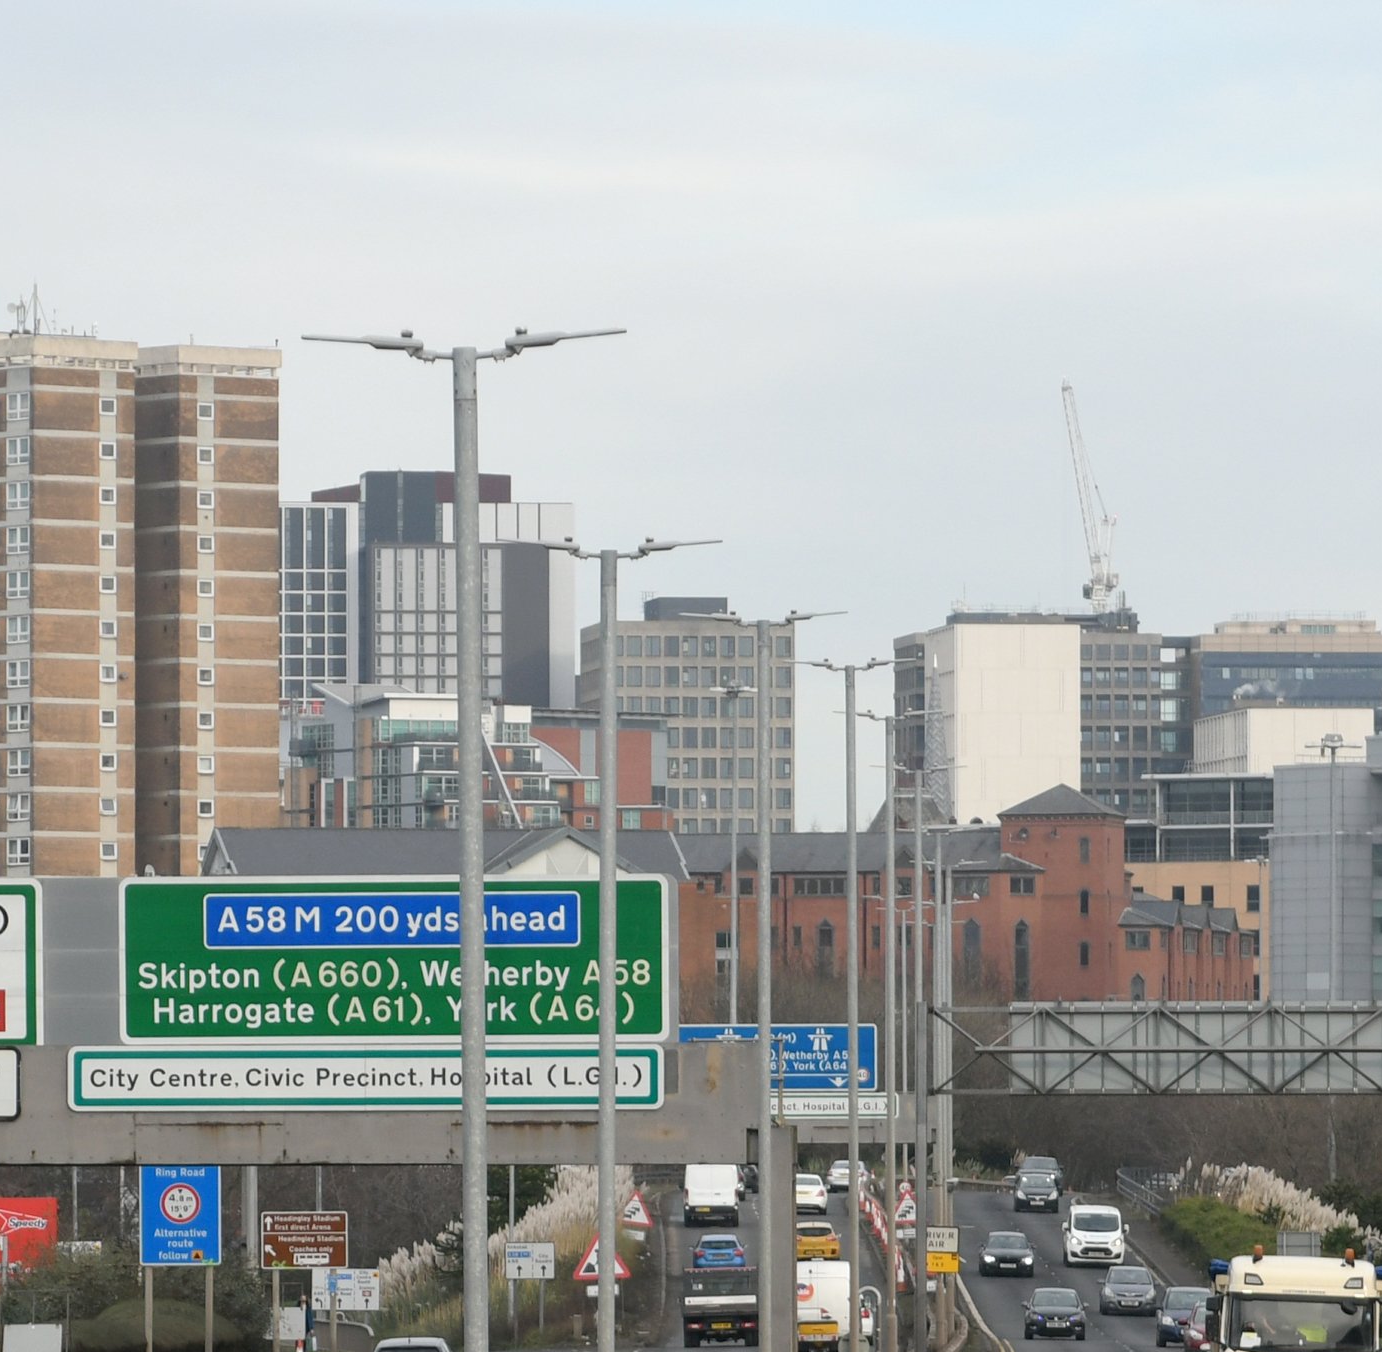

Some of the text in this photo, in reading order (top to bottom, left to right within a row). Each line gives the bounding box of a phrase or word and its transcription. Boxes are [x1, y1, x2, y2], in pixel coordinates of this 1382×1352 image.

[334, 906, 399, 934] 200
[406, 905, 459, 938] yds
[138, 957, 651, 992] Skipton (A660), Weherby A58
[152, 991, 634, 1028] Harrogate (A61), Yrk (A6)
[833, 1050, 848, 1060] A5
[793, 1061, 815, 1070] York
[819, 1061, 847, 1071] (A64
[90, 1067, 138, 1091] City
[245, 1068, 305, 1087] Civic
[430, 1066, 532, 1087] Hopital
[803, 1102, 845, 1112] Hospital
[155, 1167, 205, 1178] Ring Road
[9, 1218, 47, 1228] Speedy
[154, 1229, 207, 1238] Alternative
[167, 1239, 194, 1247] route
[158, 1251, 188, 1260] follow
